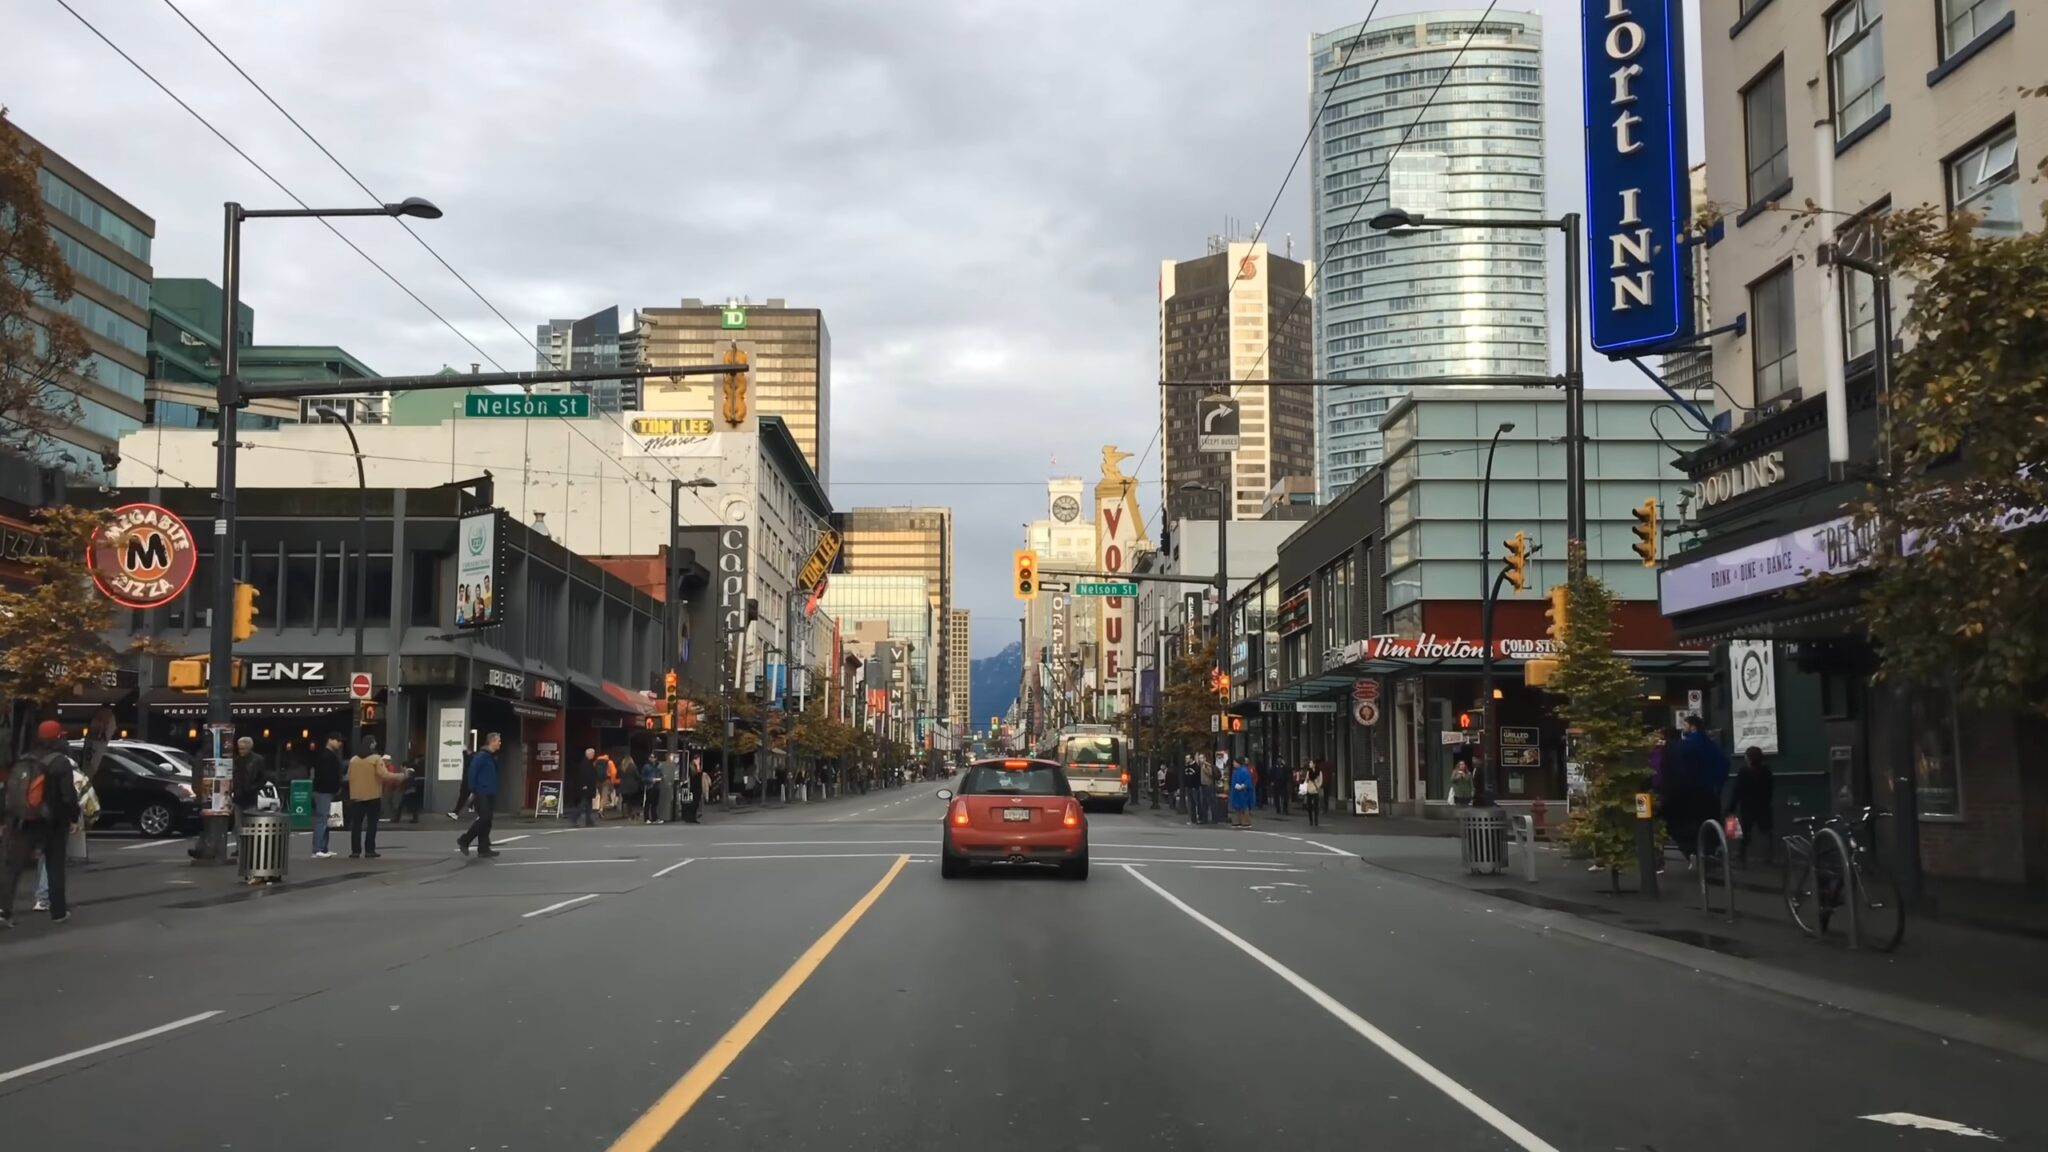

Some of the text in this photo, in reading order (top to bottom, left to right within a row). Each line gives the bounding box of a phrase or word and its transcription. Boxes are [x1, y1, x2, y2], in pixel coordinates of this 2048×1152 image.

[1609, 188, 1654, 311] INN
[724, 311, 743, 325] TD
[477, 398, 576, 415] Nelson St
[639, 419, 709, 434] TOM LEE
[1696, 452, 1783, 509] DOOLIN'S
[127, 532, 168, 571] M
[801, 535, 839, 589] TOM LEE
[1711, 551, 1793, 589] DRINK DINE DANCE
[1080, 583, 1133, 595] Nelson St
[1372, 632, 1494, 659] Tim Horton
[1500, 639, 1533, 655] COLD
[1262, 702, 1297, 711] 7-ELEVE
